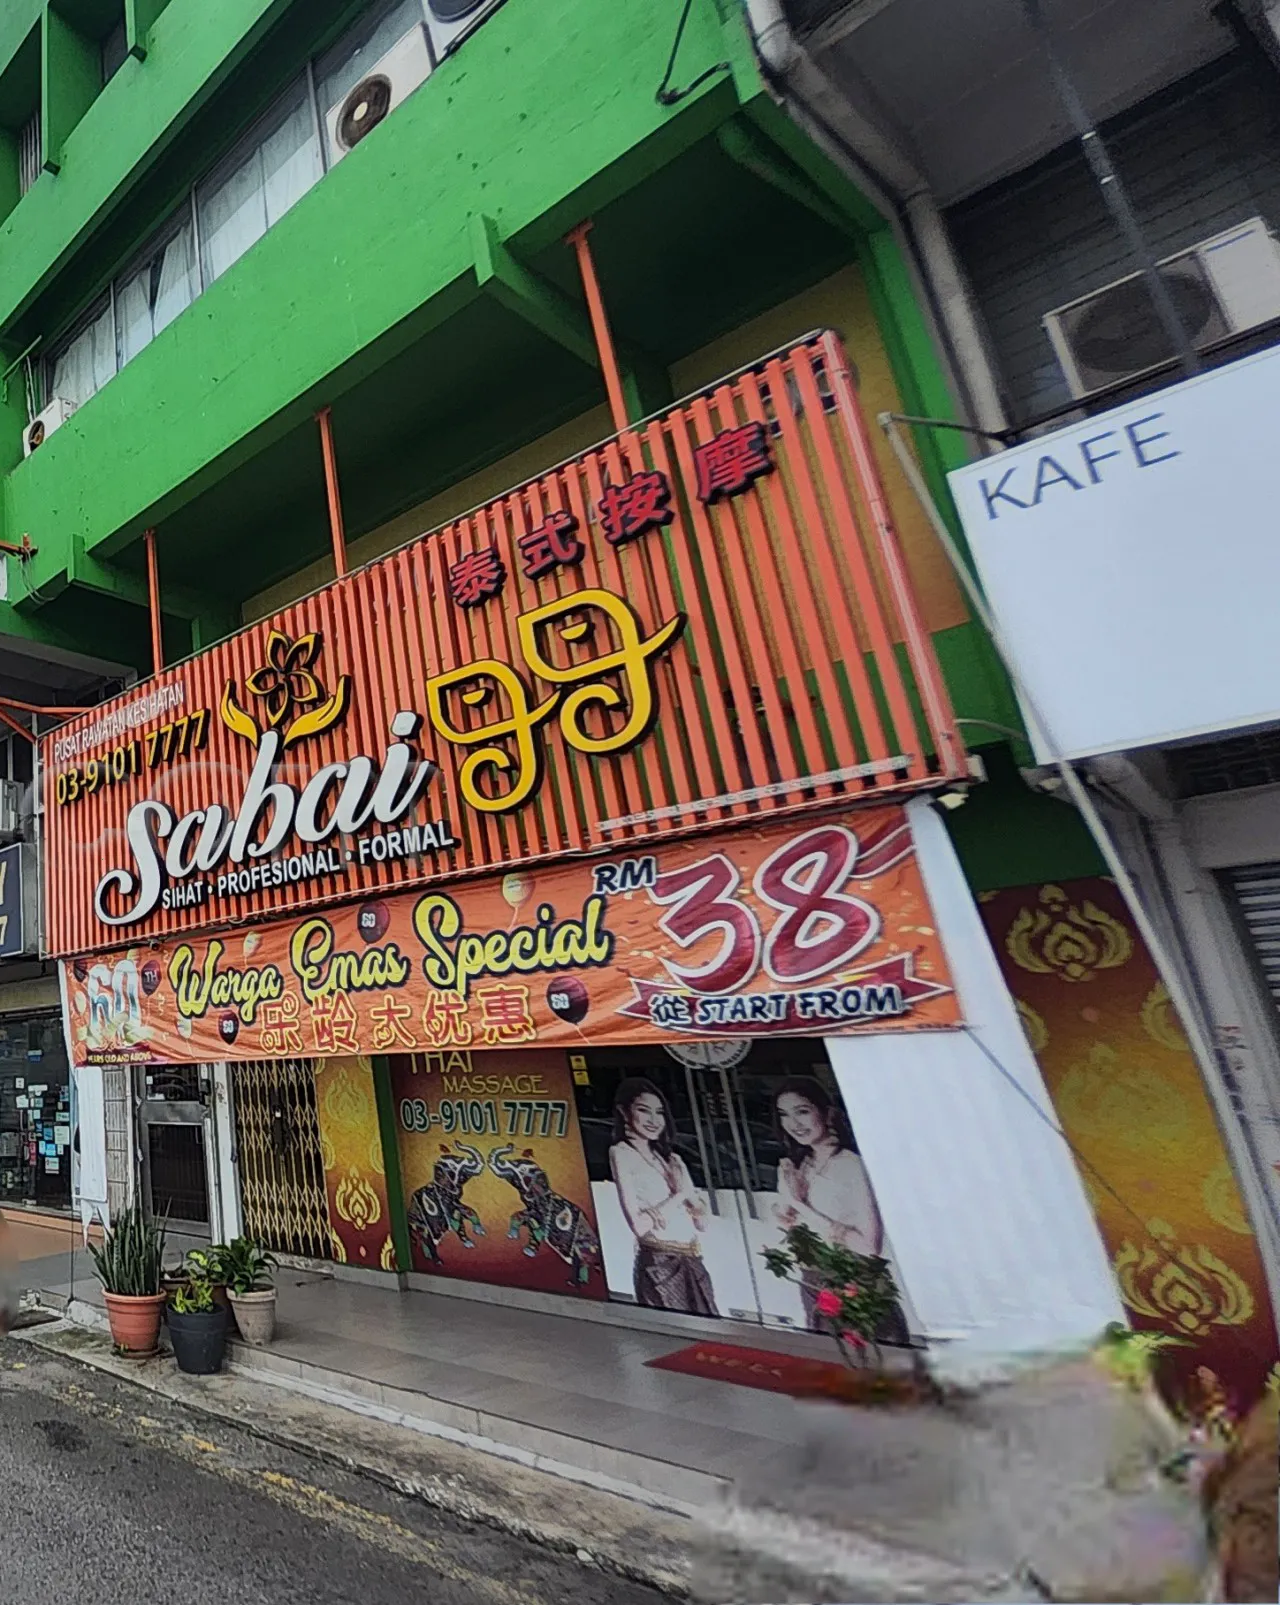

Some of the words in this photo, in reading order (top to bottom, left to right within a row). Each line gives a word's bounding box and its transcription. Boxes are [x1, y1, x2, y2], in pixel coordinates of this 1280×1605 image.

[450, 421, 774, 607] 泰式按摩
[978, 411, 1182, 521] KAFE
[54, 730, 81, 763] PUSAT
[81, 712, 125, 751] RAWATAN
[56, 740, 136, 805] 03-9101
[145, 709, 206, 768] 7777
[95, 710, 429, 926] Sabai
[162, 882, 203, 911] SIHAT
[217, 850, 341, 898] PROFESIONAL
[358, 820, 455, 865] FORMAL
[594, 856, 656, 894] RM
[646, 824, 881, 996] 38
[169, 939, 282, 1023] Warga
[292, 920, 409, 1000] Emas
[414, 895, 610, 996] Special
[695, 996, 787, 1025] START
[795, 984, 906, 1021] FROM
[400, 1098, 499, 1135] 03-9101
[502, 1100, 568, 1137] 7777
[442, 1074, 549, 1094] MASSAGE
